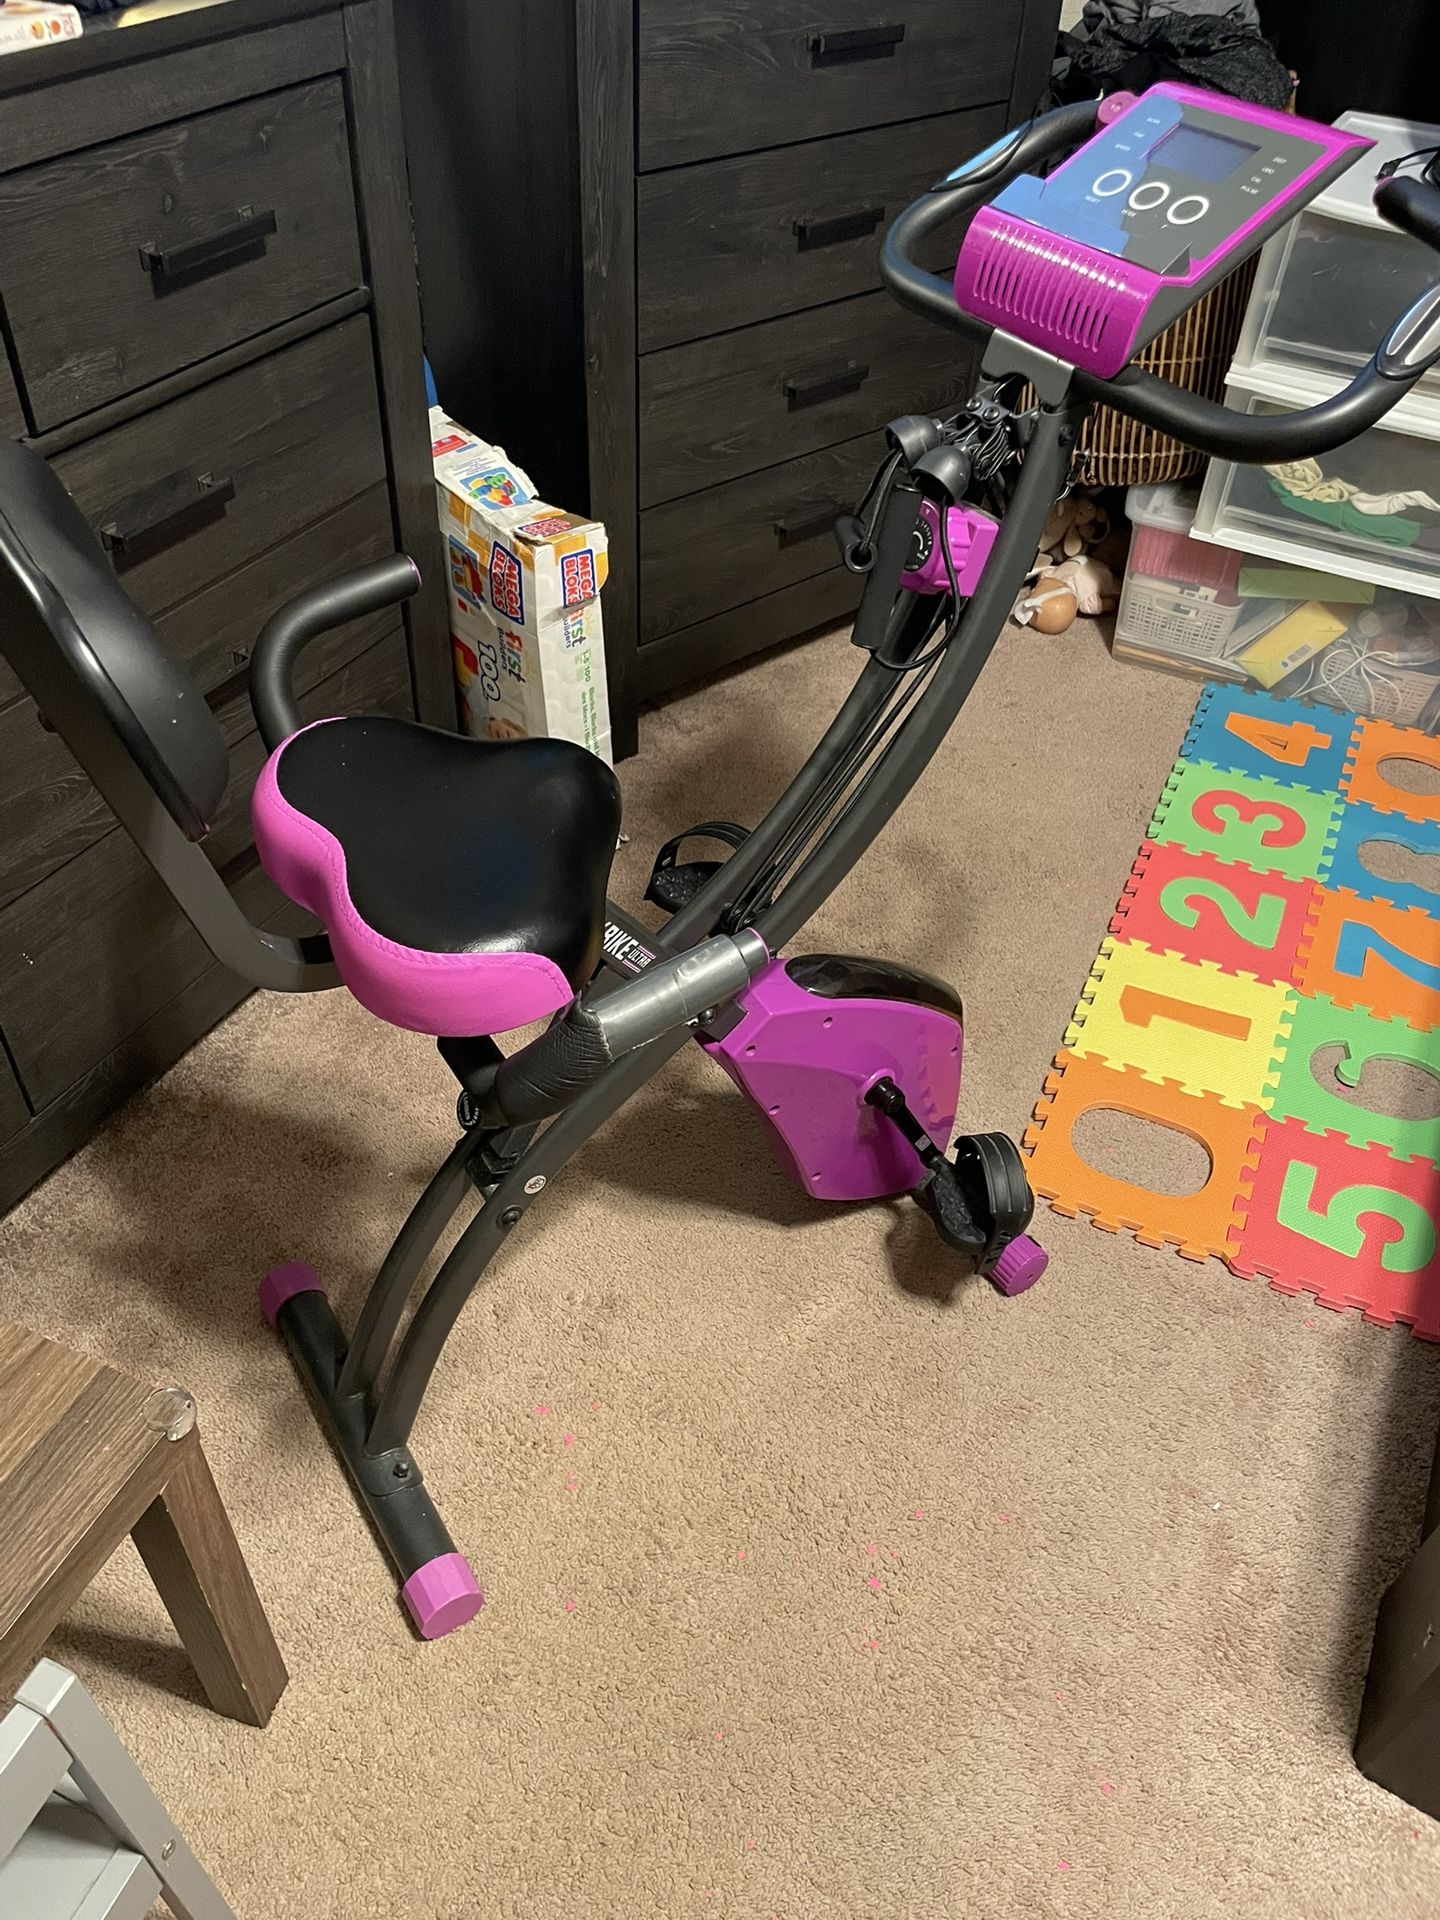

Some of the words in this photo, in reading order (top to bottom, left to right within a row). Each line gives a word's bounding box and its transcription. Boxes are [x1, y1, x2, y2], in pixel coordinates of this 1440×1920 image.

[491, 546, 507, 613] BLOKS
[504, 556, 522, 618] MEGA
[563, 557, 579, 606] BLOKS
[578, 554, 594, 602] MEGA
[505, 629, 526, 685] first
[562, 616, 571, 648] uilders
[477, 639, 501, 702] 100
[1224, 711, 1332, 767] 4
[1191, 789, 1306, 848] 3
[1160, 876, 1287, 950] 2
[603, 921, 639, 961] BIKE
[627, 948, 652, 968] ULTRA
[1333, 919, 1440, 992] 7
[1119, 985, 1252, 1041] 1
[1071, 1102, 1214, 1198] 0
[1276, 1159, 1437, 1274] 5
